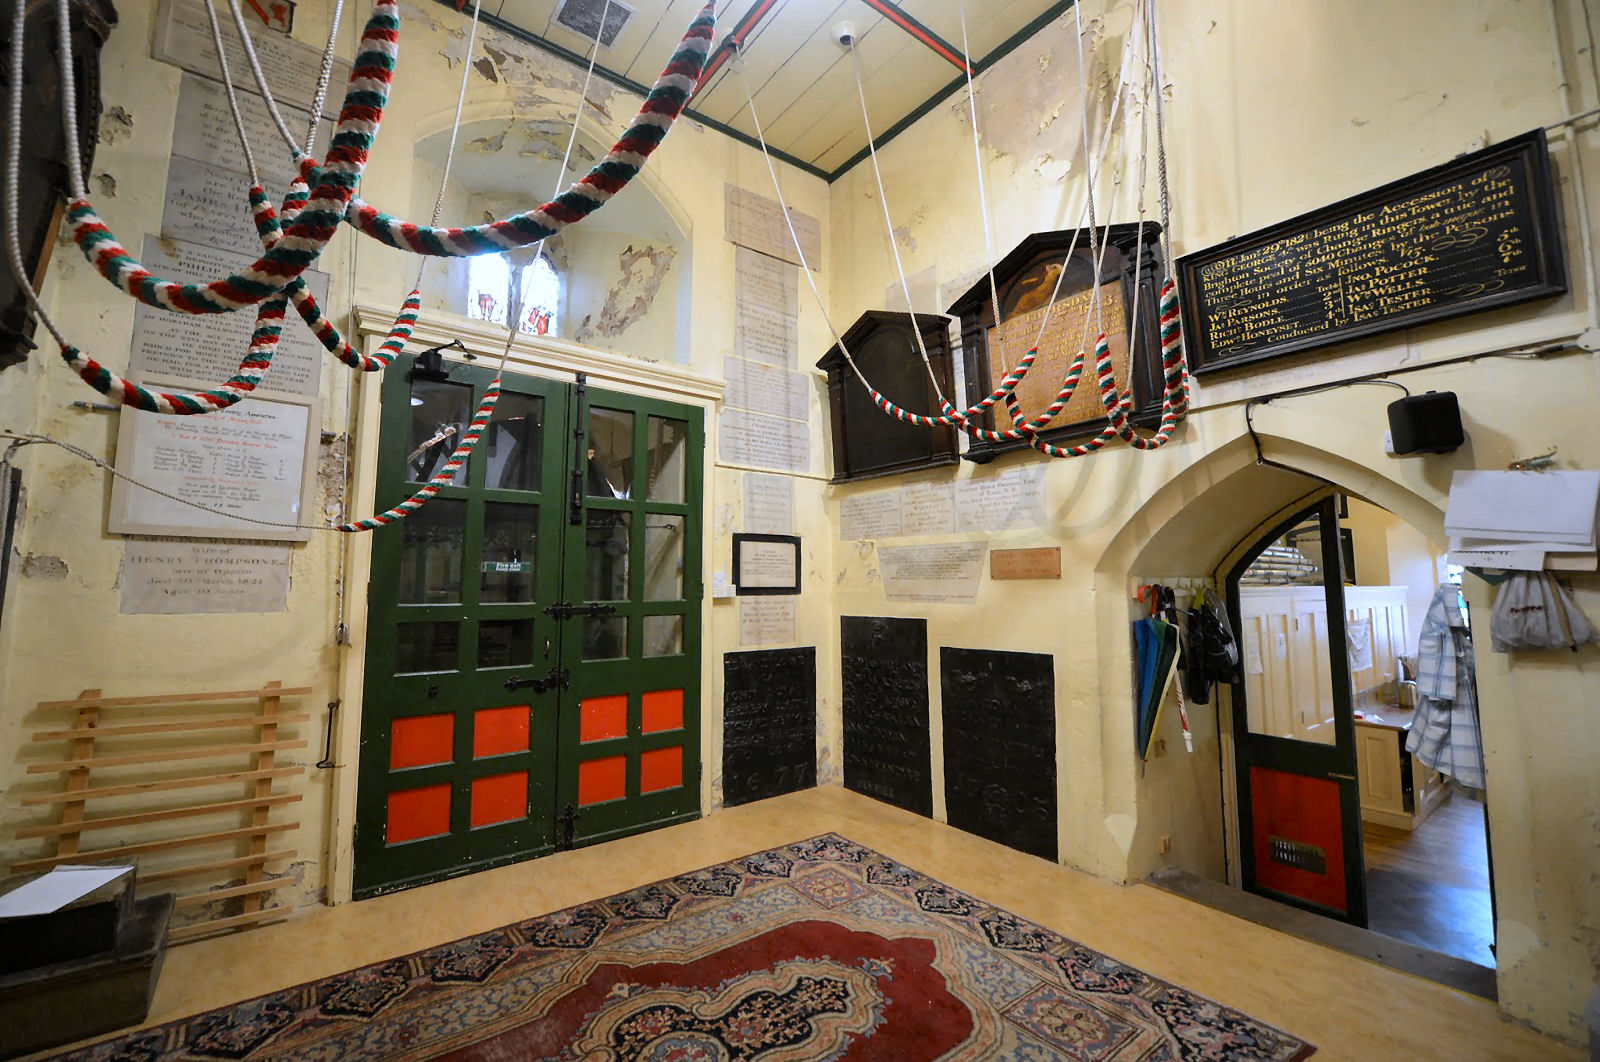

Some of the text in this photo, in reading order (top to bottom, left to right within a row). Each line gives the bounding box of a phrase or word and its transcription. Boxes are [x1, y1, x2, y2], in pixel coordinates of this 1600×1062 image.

[1232, 254, 1275, 272] GEORGE
[1379, 212, 1407, 225] this
[1484, 178, 1510, 191] the
[1313, 221, 1349, 238] being
[1353, 213, 1374, 224] the
[1379, 184, 1462, 216] Accession
[1471, 172, 1487, 185] of
[178, 260, 222, 274] PHILIP
[1203, 272, 1249, 293] Brighton
[1253, 257, 1295, 275] Society
[1299, 249, 1312, 259] of
[1316, 234, 1367, 256] Change
[1371, 216, 1425, 237] Ringers
[1481, 185, 1513, 203] and
[1204, 291, 1237, 306] Three
[1240, 282, 1272, 295] Hours
[1275, 271, 1299, 285] and
[1305, 266, 1323, 276] Six
[1390, 240, 1409, 251] by
[1413, 231, 1439, 243] the
[1445, 209, 1513, 234] Persons
[1205, 278, 1255, 300] complete
[1259, 266, 1284, 284] peal
[1288, 261, 1301, 272] of
[1336, 235, 1394, 261] Changes
[1276, 279, 1311, 293] order
[1316, 273, 1330, 282] as
[1267, 321, 1328, 342] Conducted
[1334, 316, 1349, 326] by
[194, 556, 268, 565] THOMPSON
